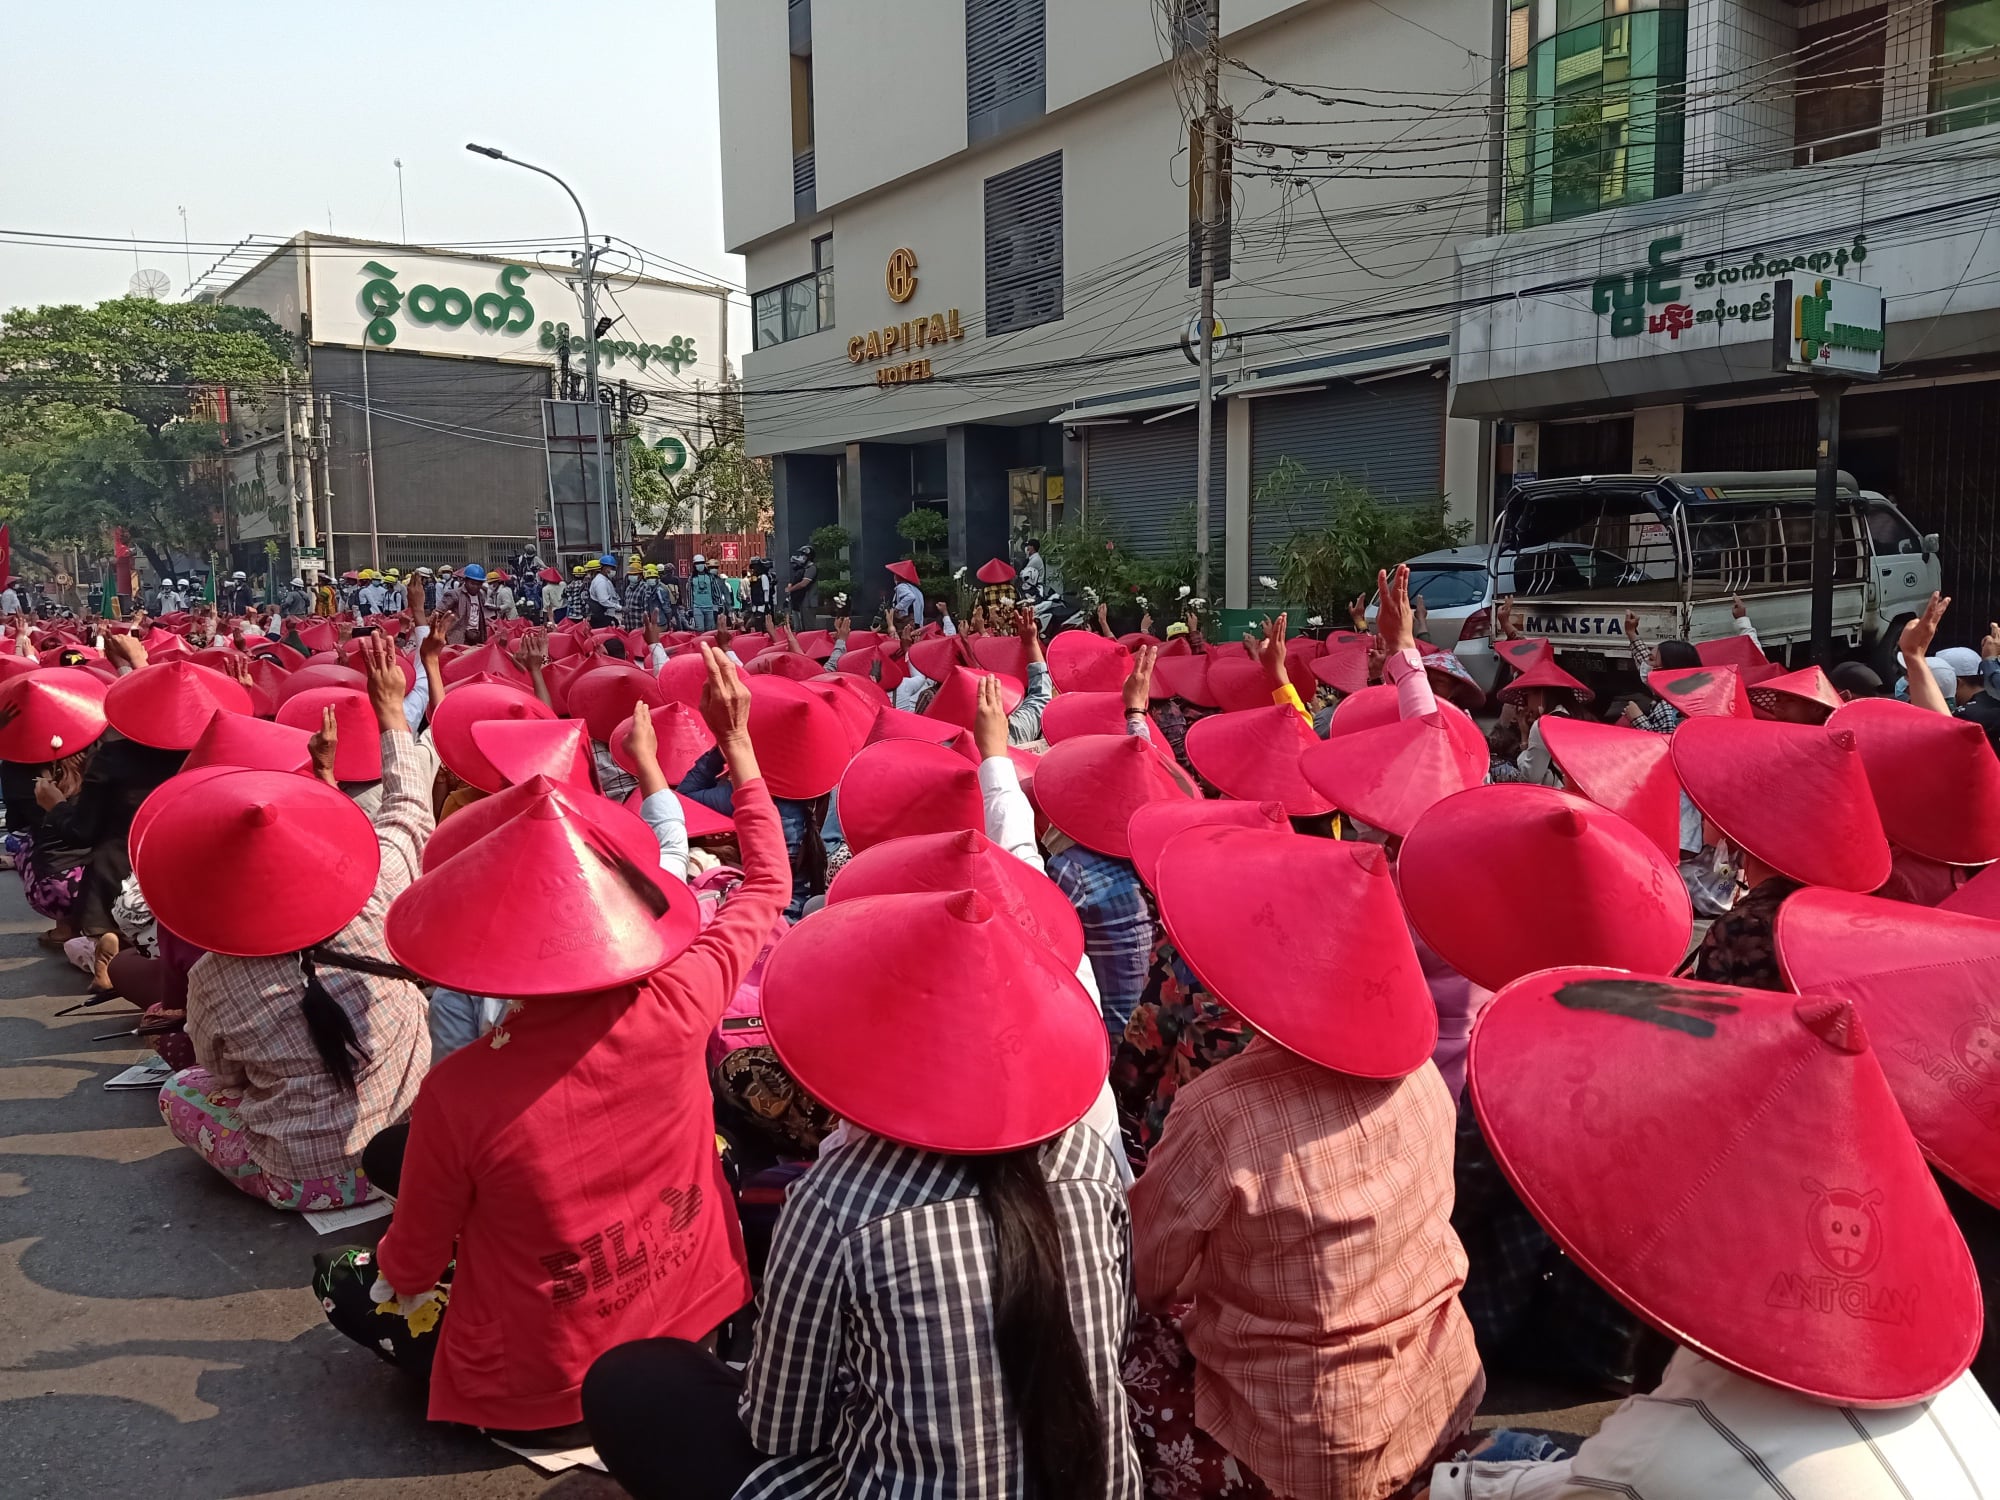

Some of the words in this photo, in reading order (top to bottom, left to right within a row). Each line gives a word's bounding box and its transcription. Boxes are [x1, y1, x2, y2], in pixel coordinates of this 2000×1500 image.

[362, 260, 535, 345] ဇွဲထက်
[847, 308, 965, 363] CAPITAL
[876, 358, 934, 387] HOTEL
[1526, 616, 1640, 635] MANSTA
